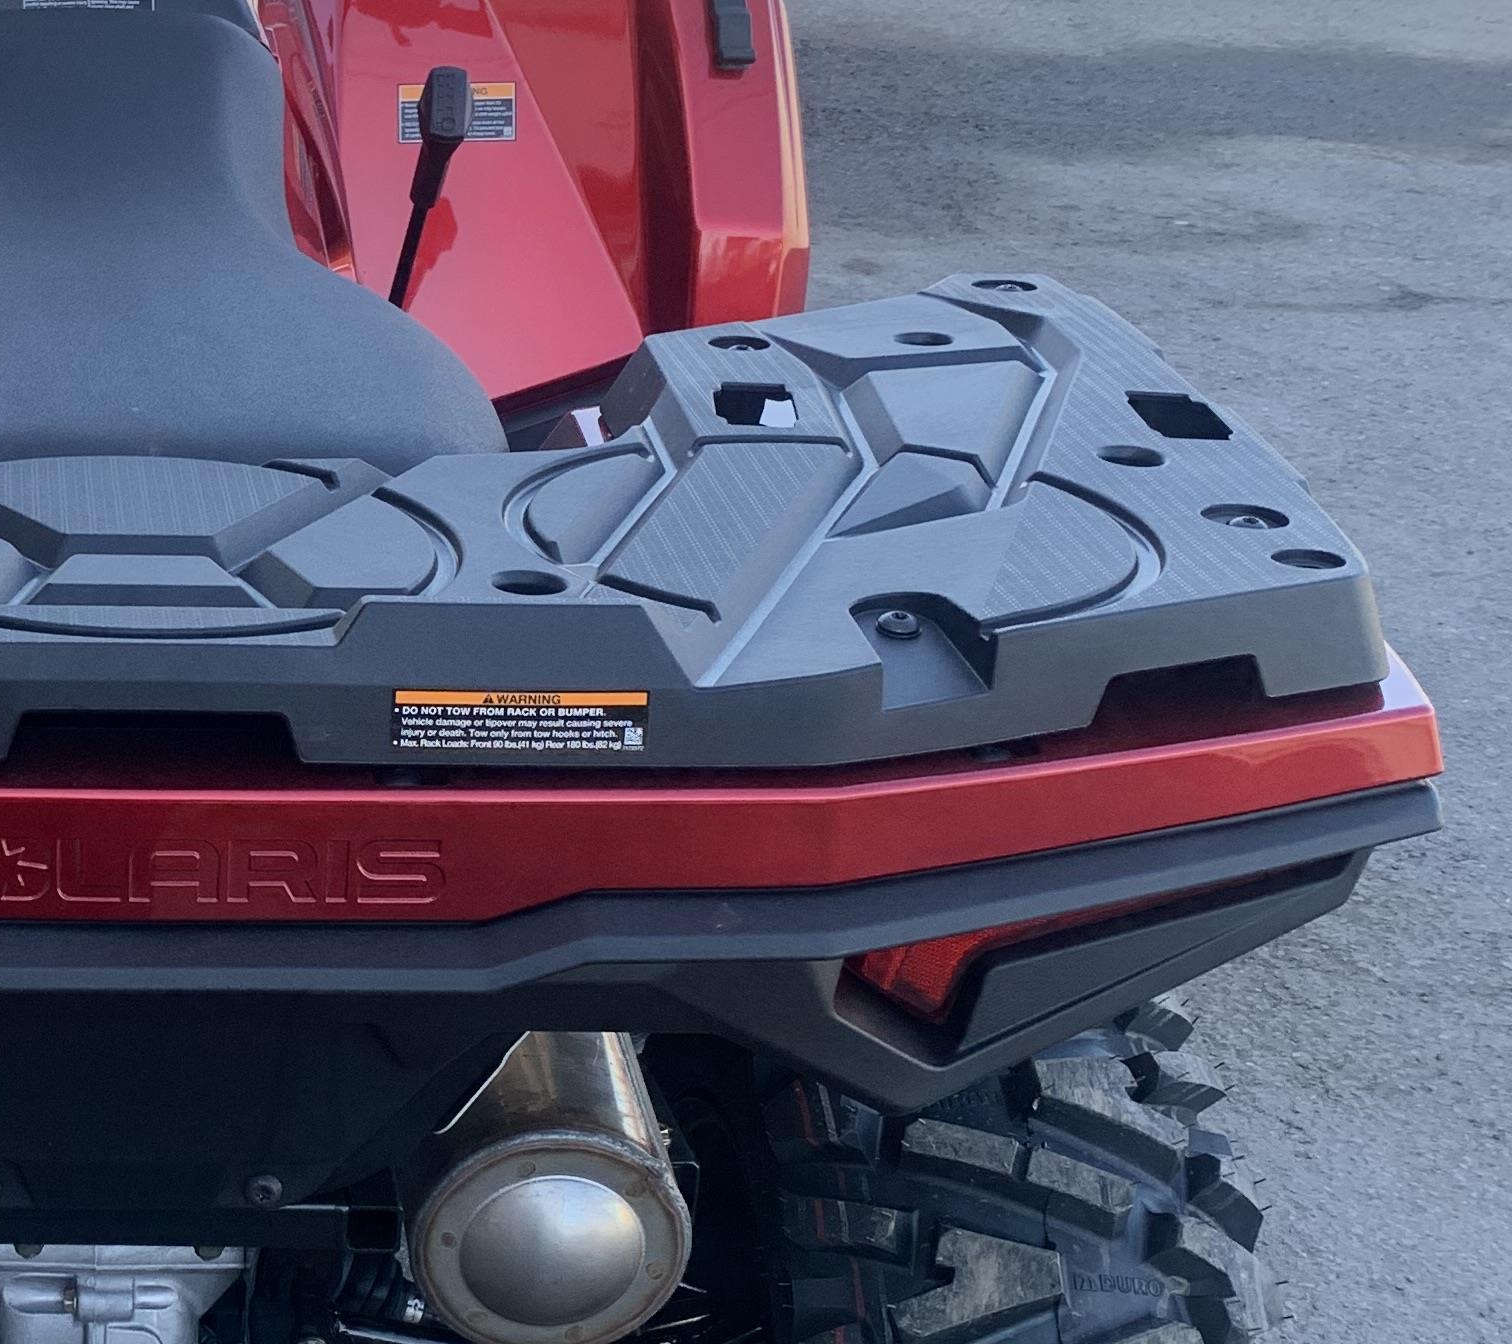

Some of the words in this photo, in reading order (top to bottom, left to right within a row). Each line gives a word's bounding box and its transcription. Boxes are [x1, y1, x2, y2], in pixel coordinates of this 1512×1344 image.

[497, 694, 561, 704] WARNING
[402, 706, 418, 715] DO
[421, 707, 444, 715] NOT
[446, 707, 471, 715] TOW
[473, 707, 504, 716] FROM
[507, 708, 537, 716] RACK
[539, 708, 555, 716] OR
[557, 708, 606, 716] BUMPER.
[401, 717, 433, 726] Vehicle
[435, 717, 471, 727] damage
[485, 718, 516, 727] tipover
[518, 720, 537, 728] may
[539, 719, 565, 727] result
[566, 719, 601, 729] causing
[400, 728, 425, 738] injury
[438, 728, 467, 737] death.
[469, 729, 488, 737] Tow
[489, 729, 509, 739] only
[510, 729, 532, 737] from
[533, 730, 550, 738] tow
[552, 730, 580, 738] hooks
[420, 739, 441, 747] Rack
[470, 739, 492, 748] Front
[545, 741, 565, 749] Rear
